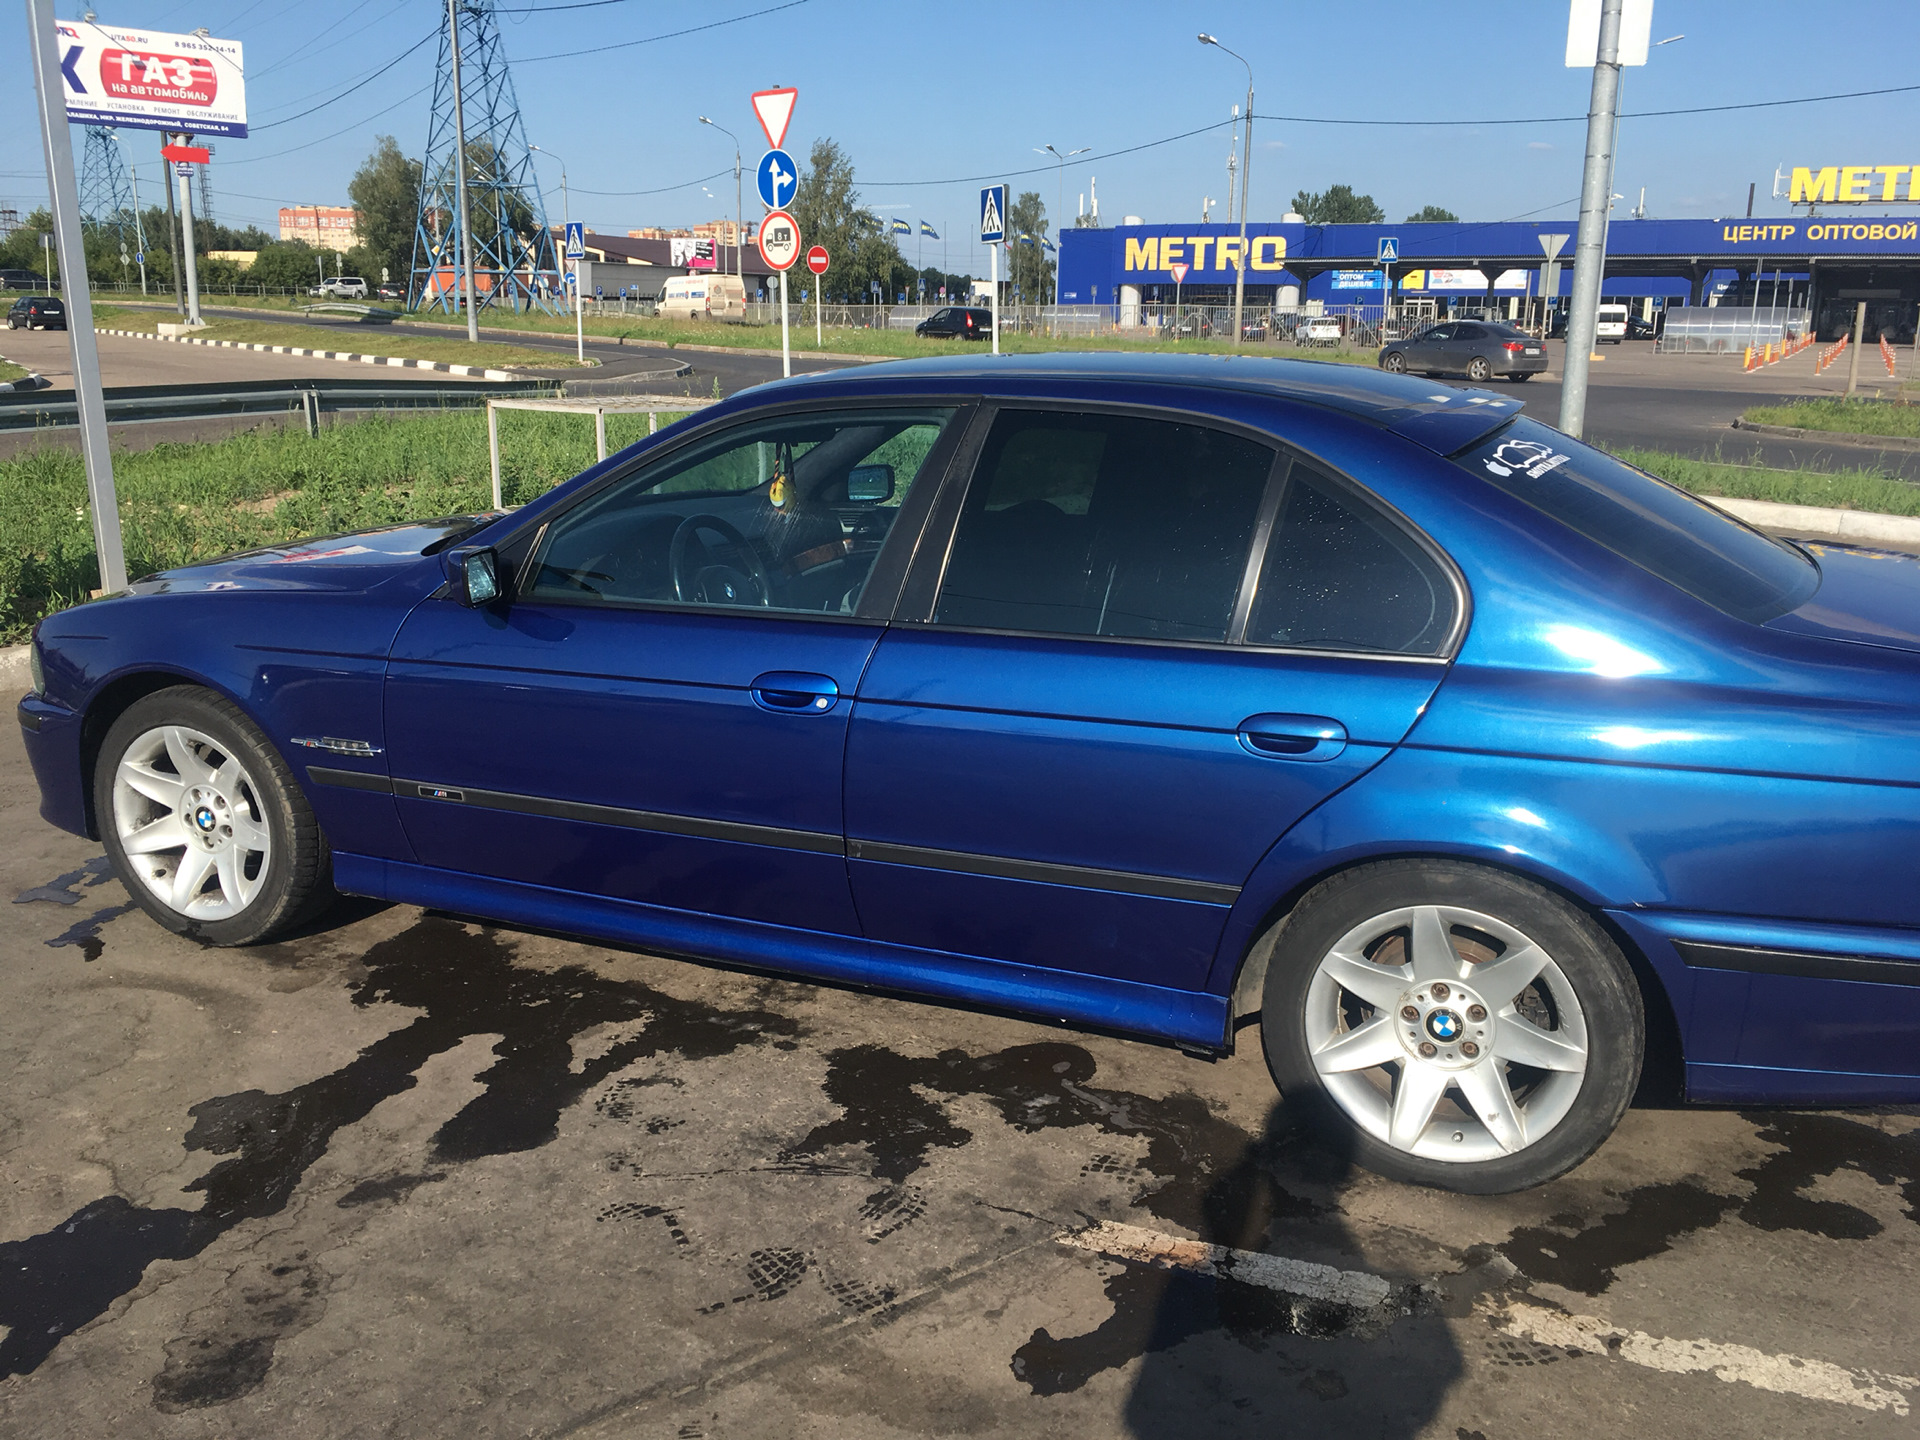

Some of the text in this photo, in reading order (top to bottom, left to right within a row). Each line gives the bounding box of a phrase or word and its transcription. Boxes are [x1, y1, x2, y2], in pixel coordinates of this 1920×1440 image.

[121, 53, 194, 88] ГАЗ
[111, 83, 208, 101] на автомобиль
[107, 102, 145, 111] УСТАНОВКА
[154, 107, 180, 115] РЕМОНТ
[186, 110, 239, 120] ОБСЛУЖИВАНИЕ
[777, 232, 782, 241] 8
[1723, 221, 1918, 243] ЦЕНТР ОПТОВОЙ
[1124, 236, 1287, 271] METRO
